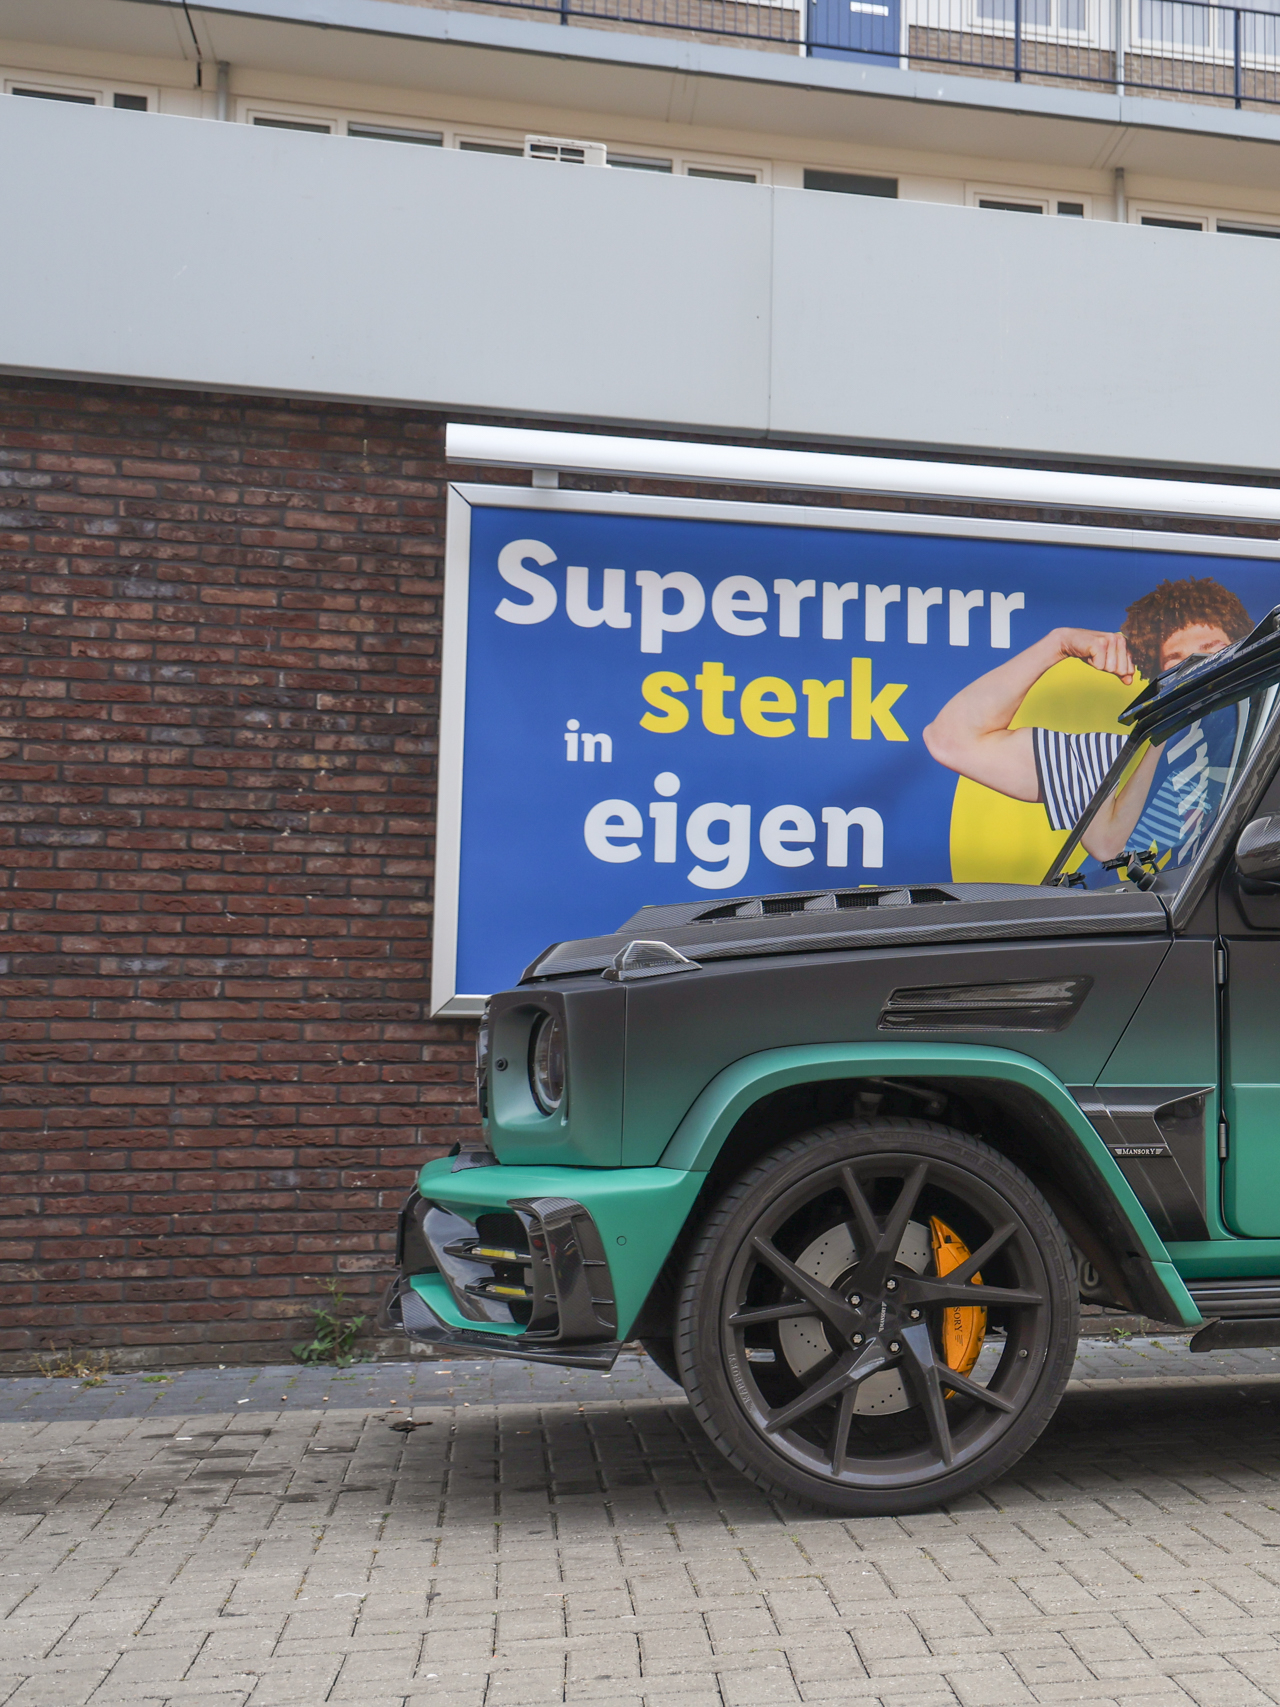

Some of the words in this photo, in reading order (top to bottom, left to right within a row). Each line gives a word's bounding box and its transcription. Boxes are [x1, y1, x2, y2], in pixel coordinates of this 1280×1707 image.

[494, 539, 1025, 654] Superrrrrr
[565, 718, 613, 762] in
[640, 657, 909, 743] sterk
[583, 771, 884, 890] eigen
[953, 1306, 963, 1333] SORY
